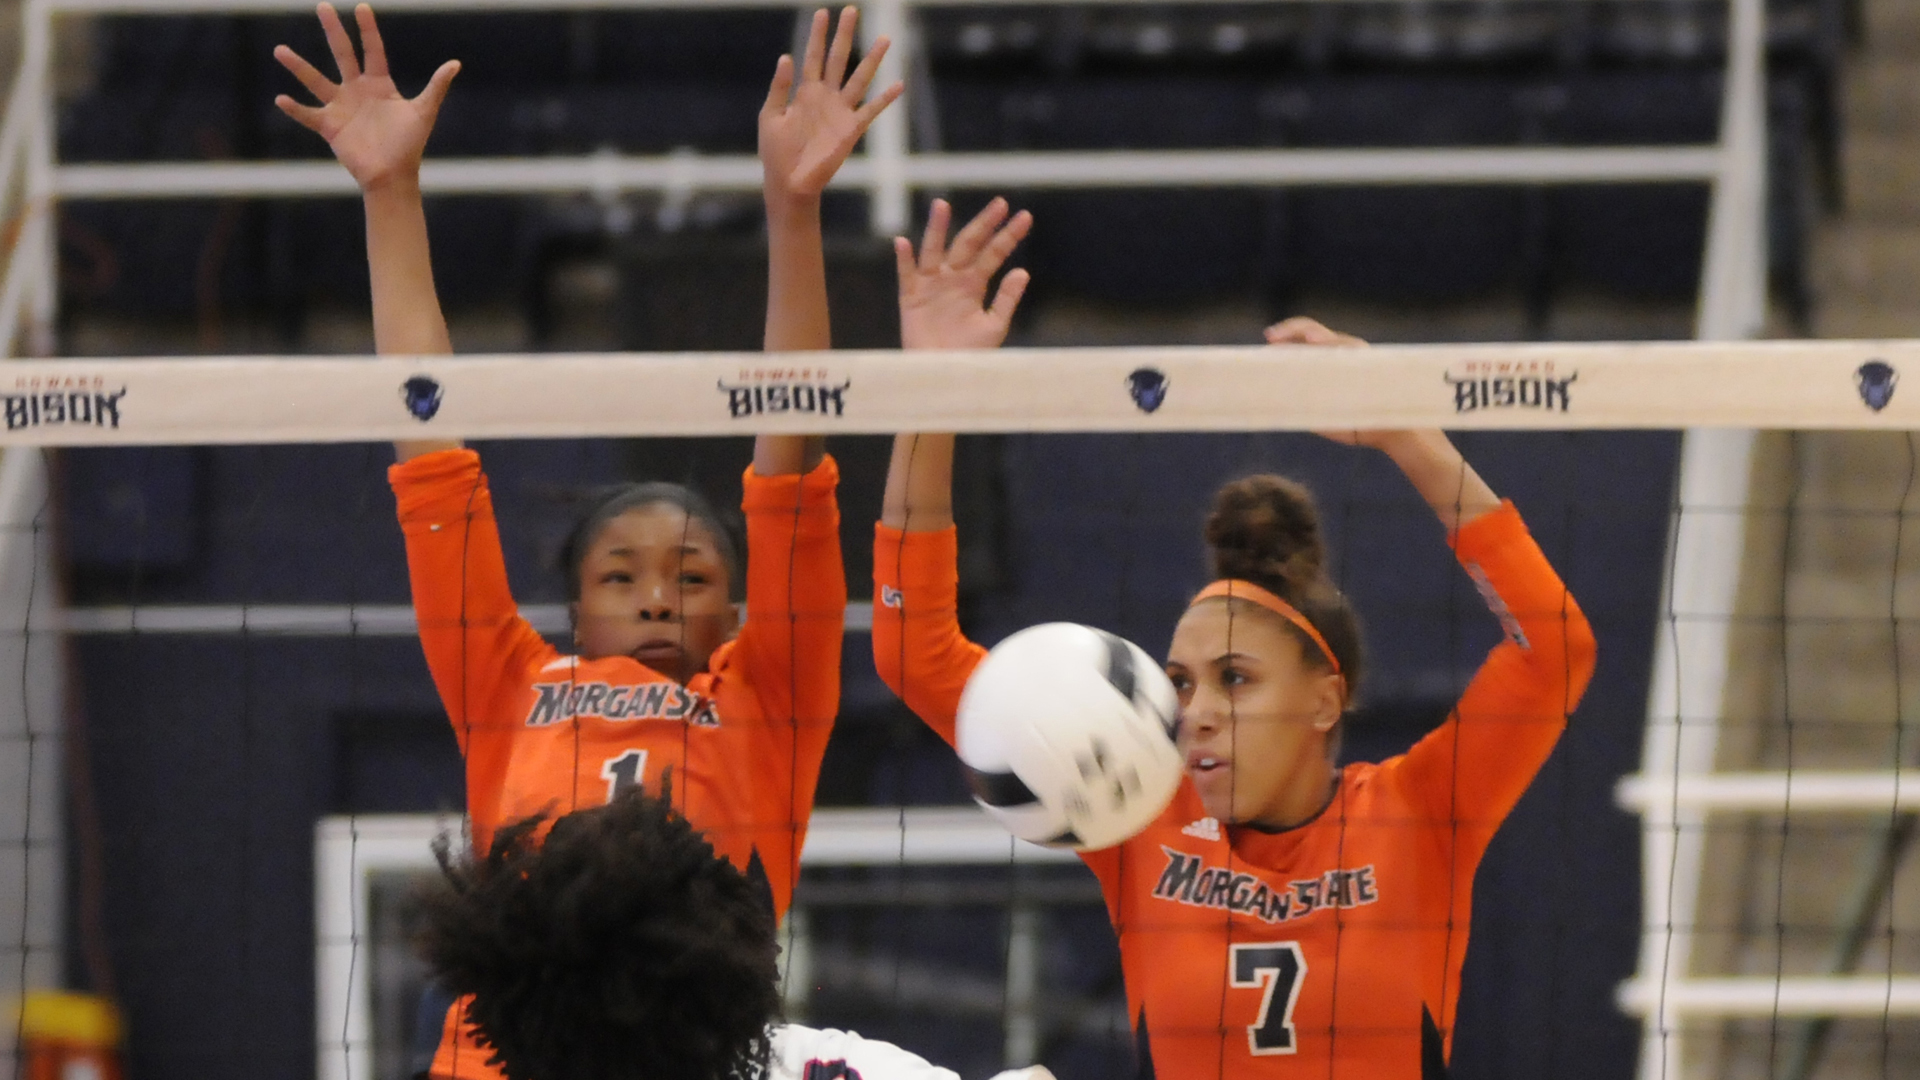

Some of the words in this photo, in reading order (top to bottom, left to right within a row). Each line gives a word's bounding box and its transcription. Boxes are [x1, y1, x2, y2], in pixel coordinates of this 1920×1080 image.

[15, 376, 103, 388] HOWARD
[739, 369, 828, 381] HOWARD
[1466, 360, 1555, 373] HOWARD
[0, 385, 126, 430] BISON
[717, 378, 851, 418] BISON
[1444, 369, 1578, 413] BISON
[525, 680, 669, 727] MORGAN
[600, 748, 649, 805] 1
[1152, 844, 1291, 924] MORGAN
[1287, 864, 1379, 920] STATE
[1229, 940, 1308, 1056] 7
